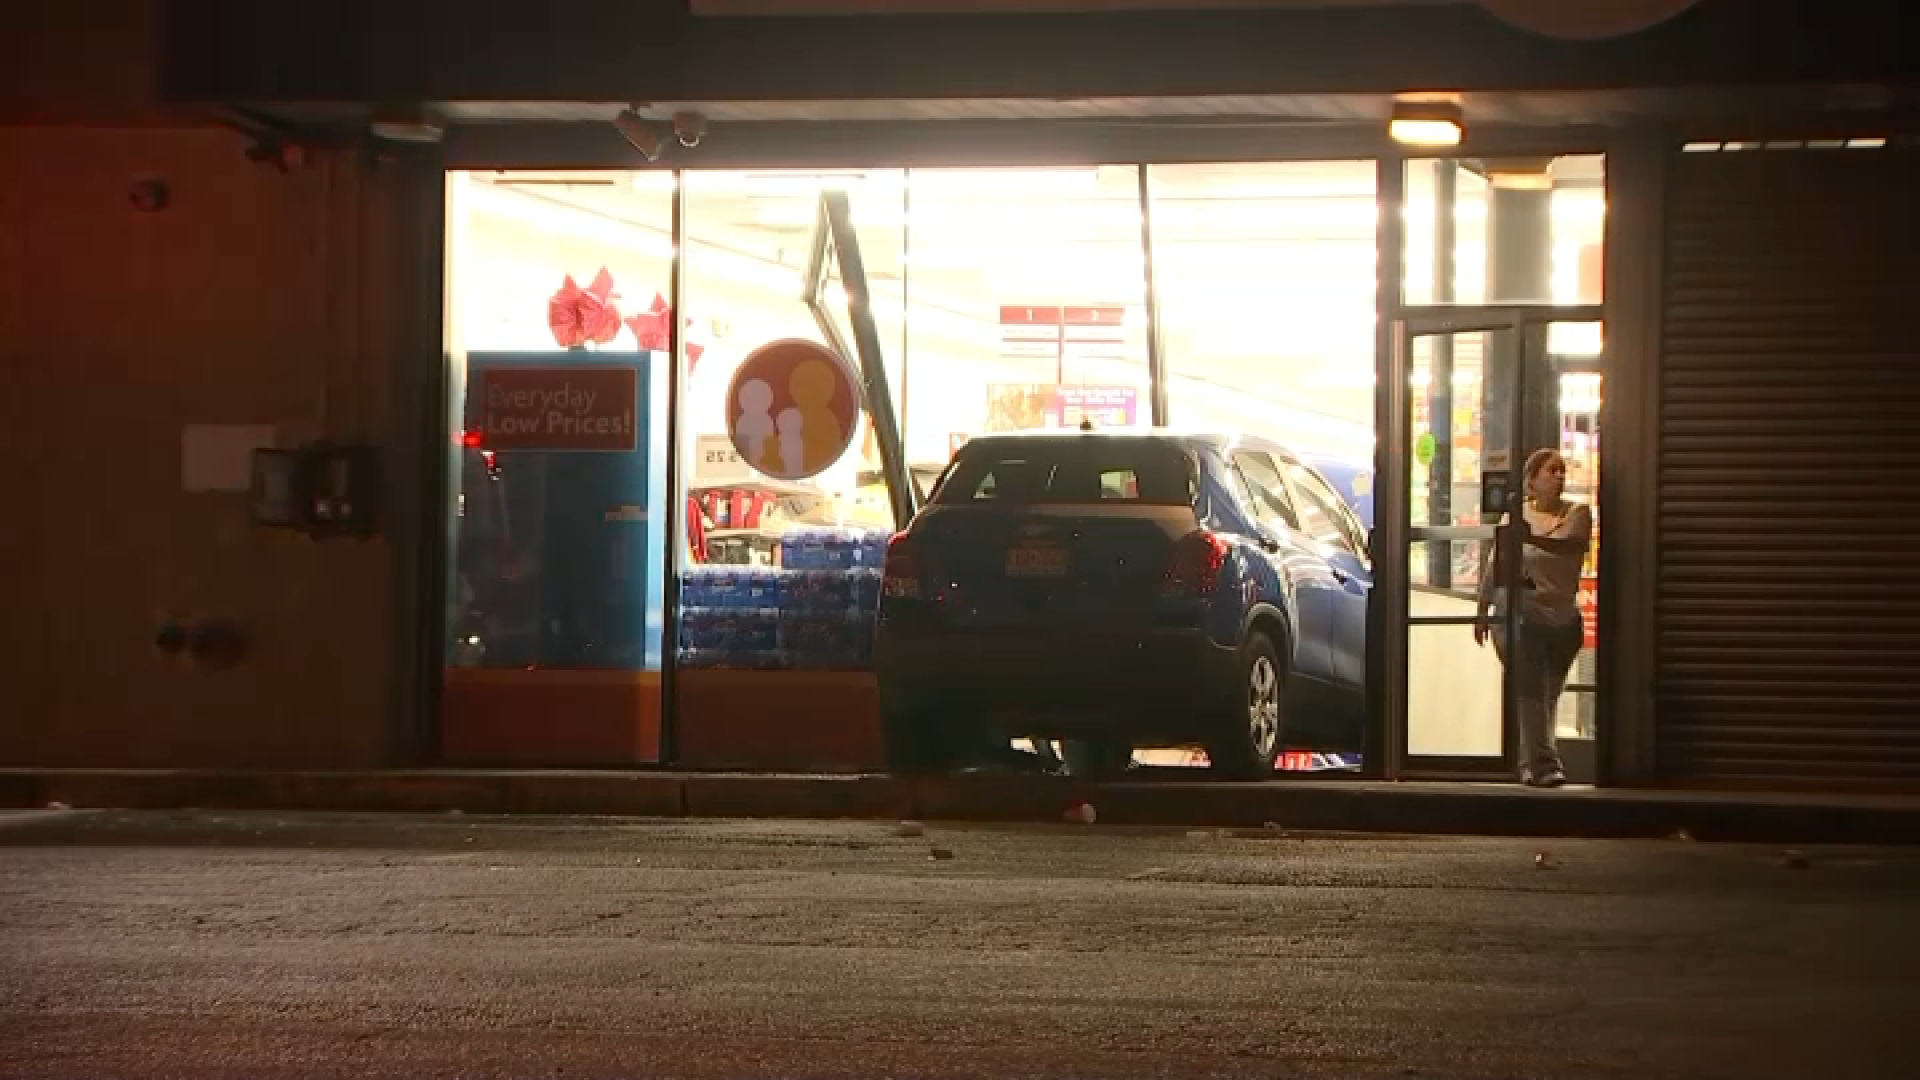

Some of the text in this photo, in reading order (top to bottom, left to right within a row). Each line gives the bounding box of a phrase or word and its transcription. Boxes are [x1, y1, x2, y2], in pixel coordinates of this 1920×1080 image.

[487, 381, 598, 414] Everyday
[487, 408, 631, 434] Low Prices!
